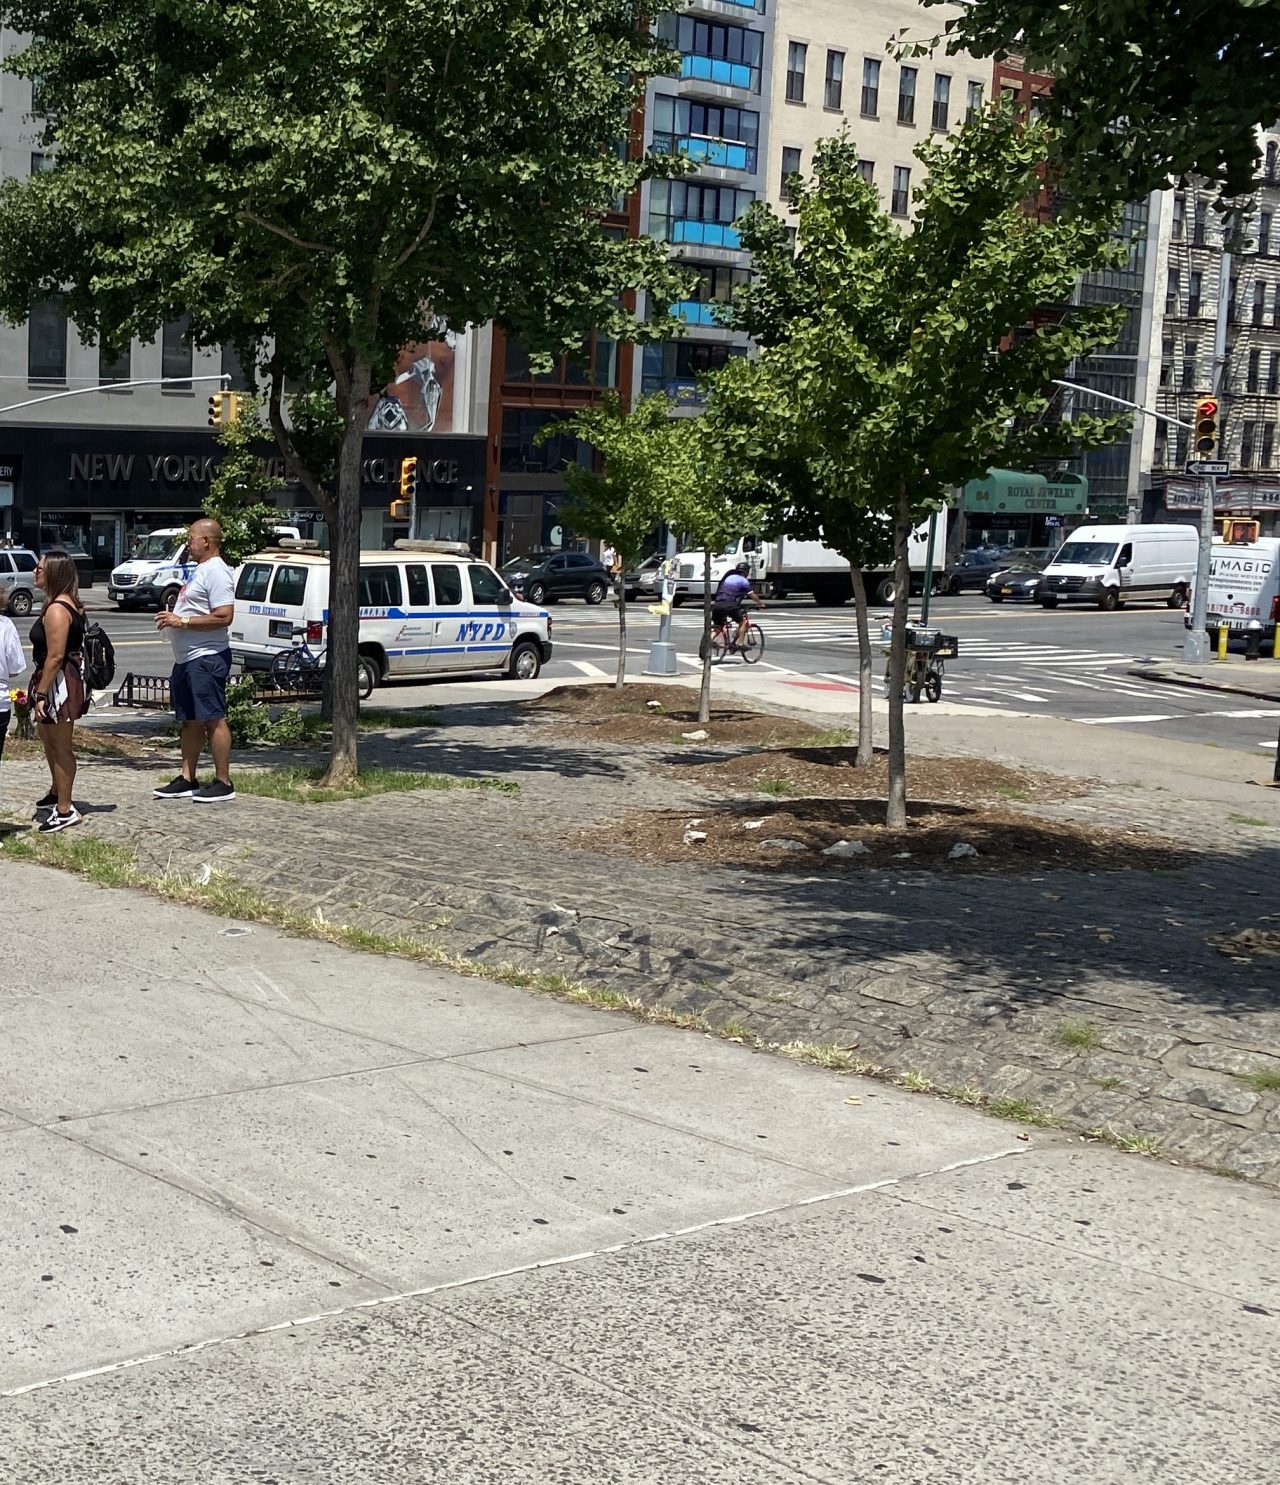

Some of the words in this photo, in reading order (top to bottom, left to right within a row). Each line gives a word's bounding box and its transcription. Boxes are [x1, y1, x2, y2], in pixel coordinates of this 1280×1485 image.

[69, 453, 136, 481] NEW
[147, 454, 215, 482] YORK
[1007, 486, 1035, 498] ROYAL
[1037, 487, 1077, 498] JEWELRY
[1024, 498, 1058, 510] CENTER
[1220, 560, 1272, 574] MAGIC
[455, 622, 506, 642] NYPD
